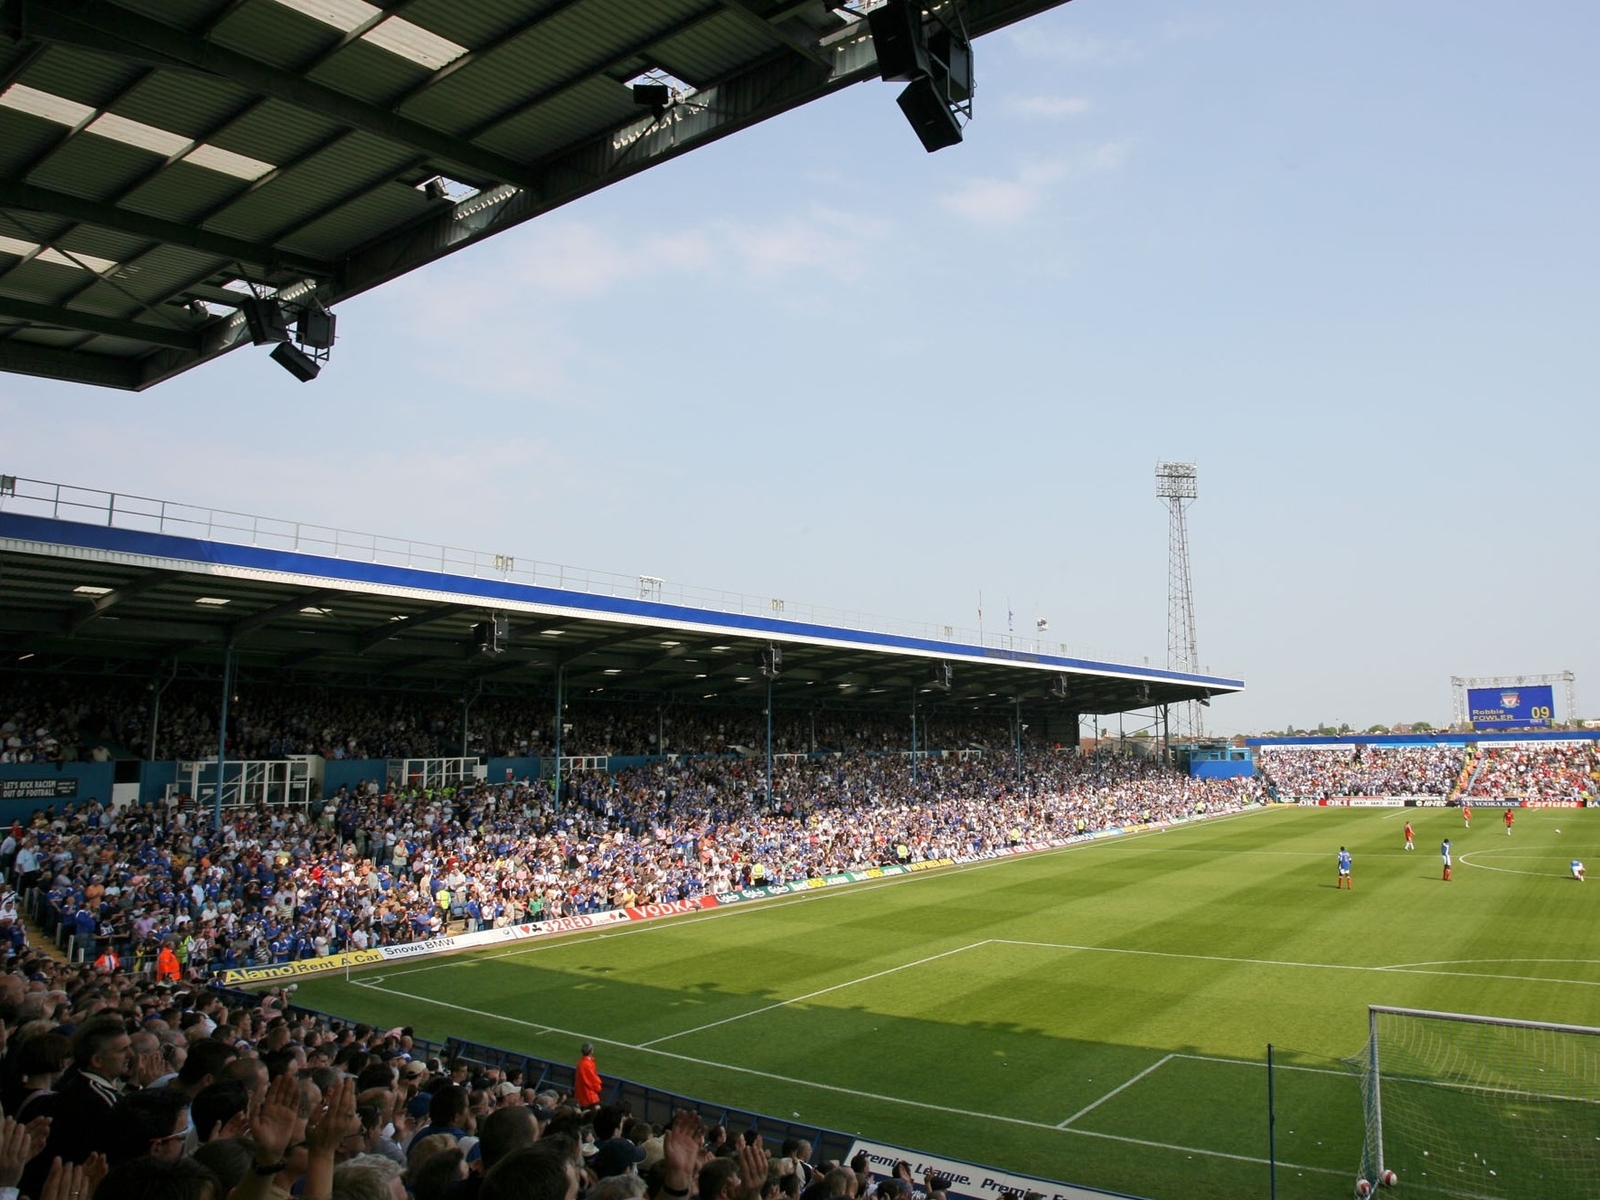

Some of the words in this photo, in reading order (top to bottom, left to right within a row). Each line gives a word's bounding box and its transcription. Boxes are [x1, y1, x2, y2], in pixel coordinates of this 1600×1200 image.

[1531, 706, 1550, 719] 09
[20, 780, 34, 789] KICK
[34, 780, 57, 789] RACISM
[3, 789, 16, 798] OUT
[16, 789, 25, 797] OF
[26, 788, 55, 797] FOOTBALL
[1300, 799, 1319, 807] OKI
[1326, 799, 1348, 807] OKI
[790, 876, 850, 892] bet365.com
[384, 943, 424, 955] Snows
[425, 938, 455, 949] BMW
[225, 966, 294, 984] Alamo
[298, 960, 334, 973] Rent
[341, 957, 351, 966] A
[354, 953, 379, 963] Car
